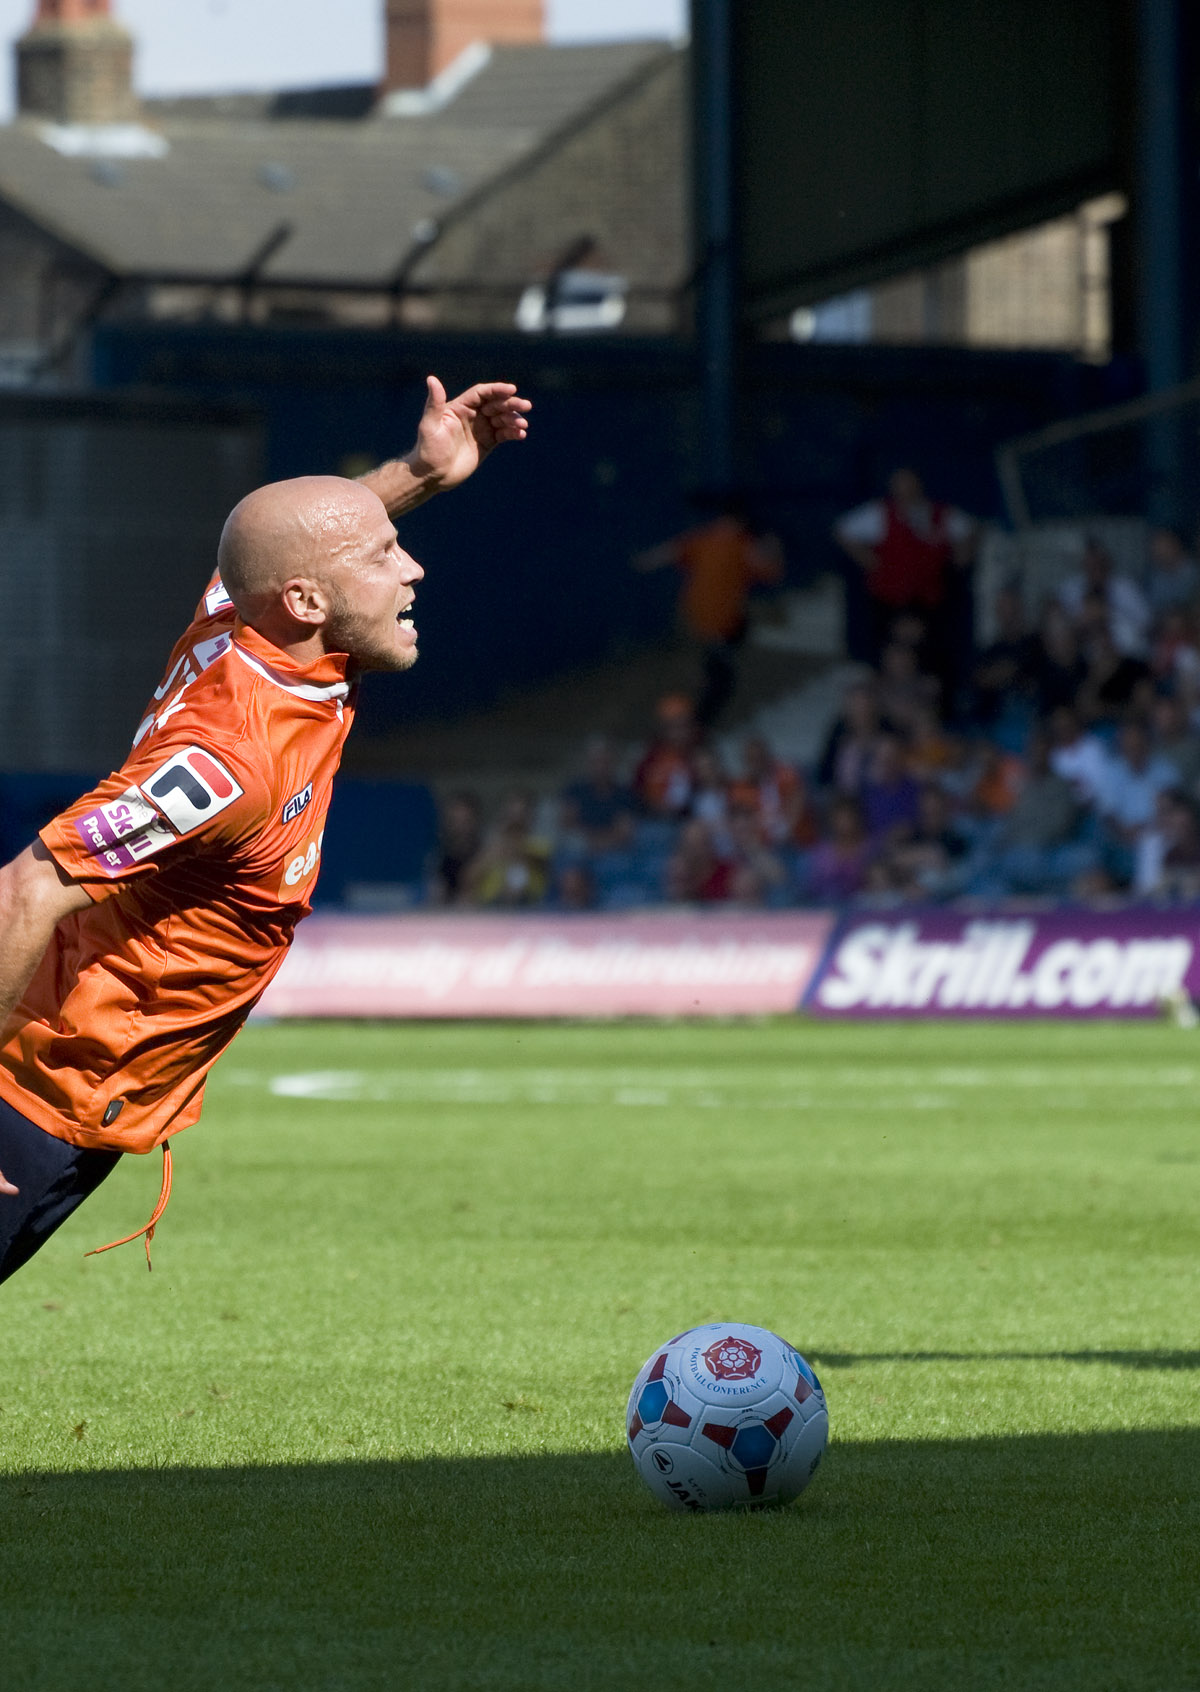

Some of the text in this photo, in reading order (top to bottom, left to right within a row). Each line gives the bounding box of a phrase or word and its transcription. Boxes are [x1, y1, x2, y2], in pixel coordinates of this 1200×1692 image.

[286, 790, 310, 821] FILA
[821, 919, 1191, 1008] Skrill.com
[689, 1347, 707, 1386] FOOTBALL
[706, 1376, 767, 1395] CONFERENCE
